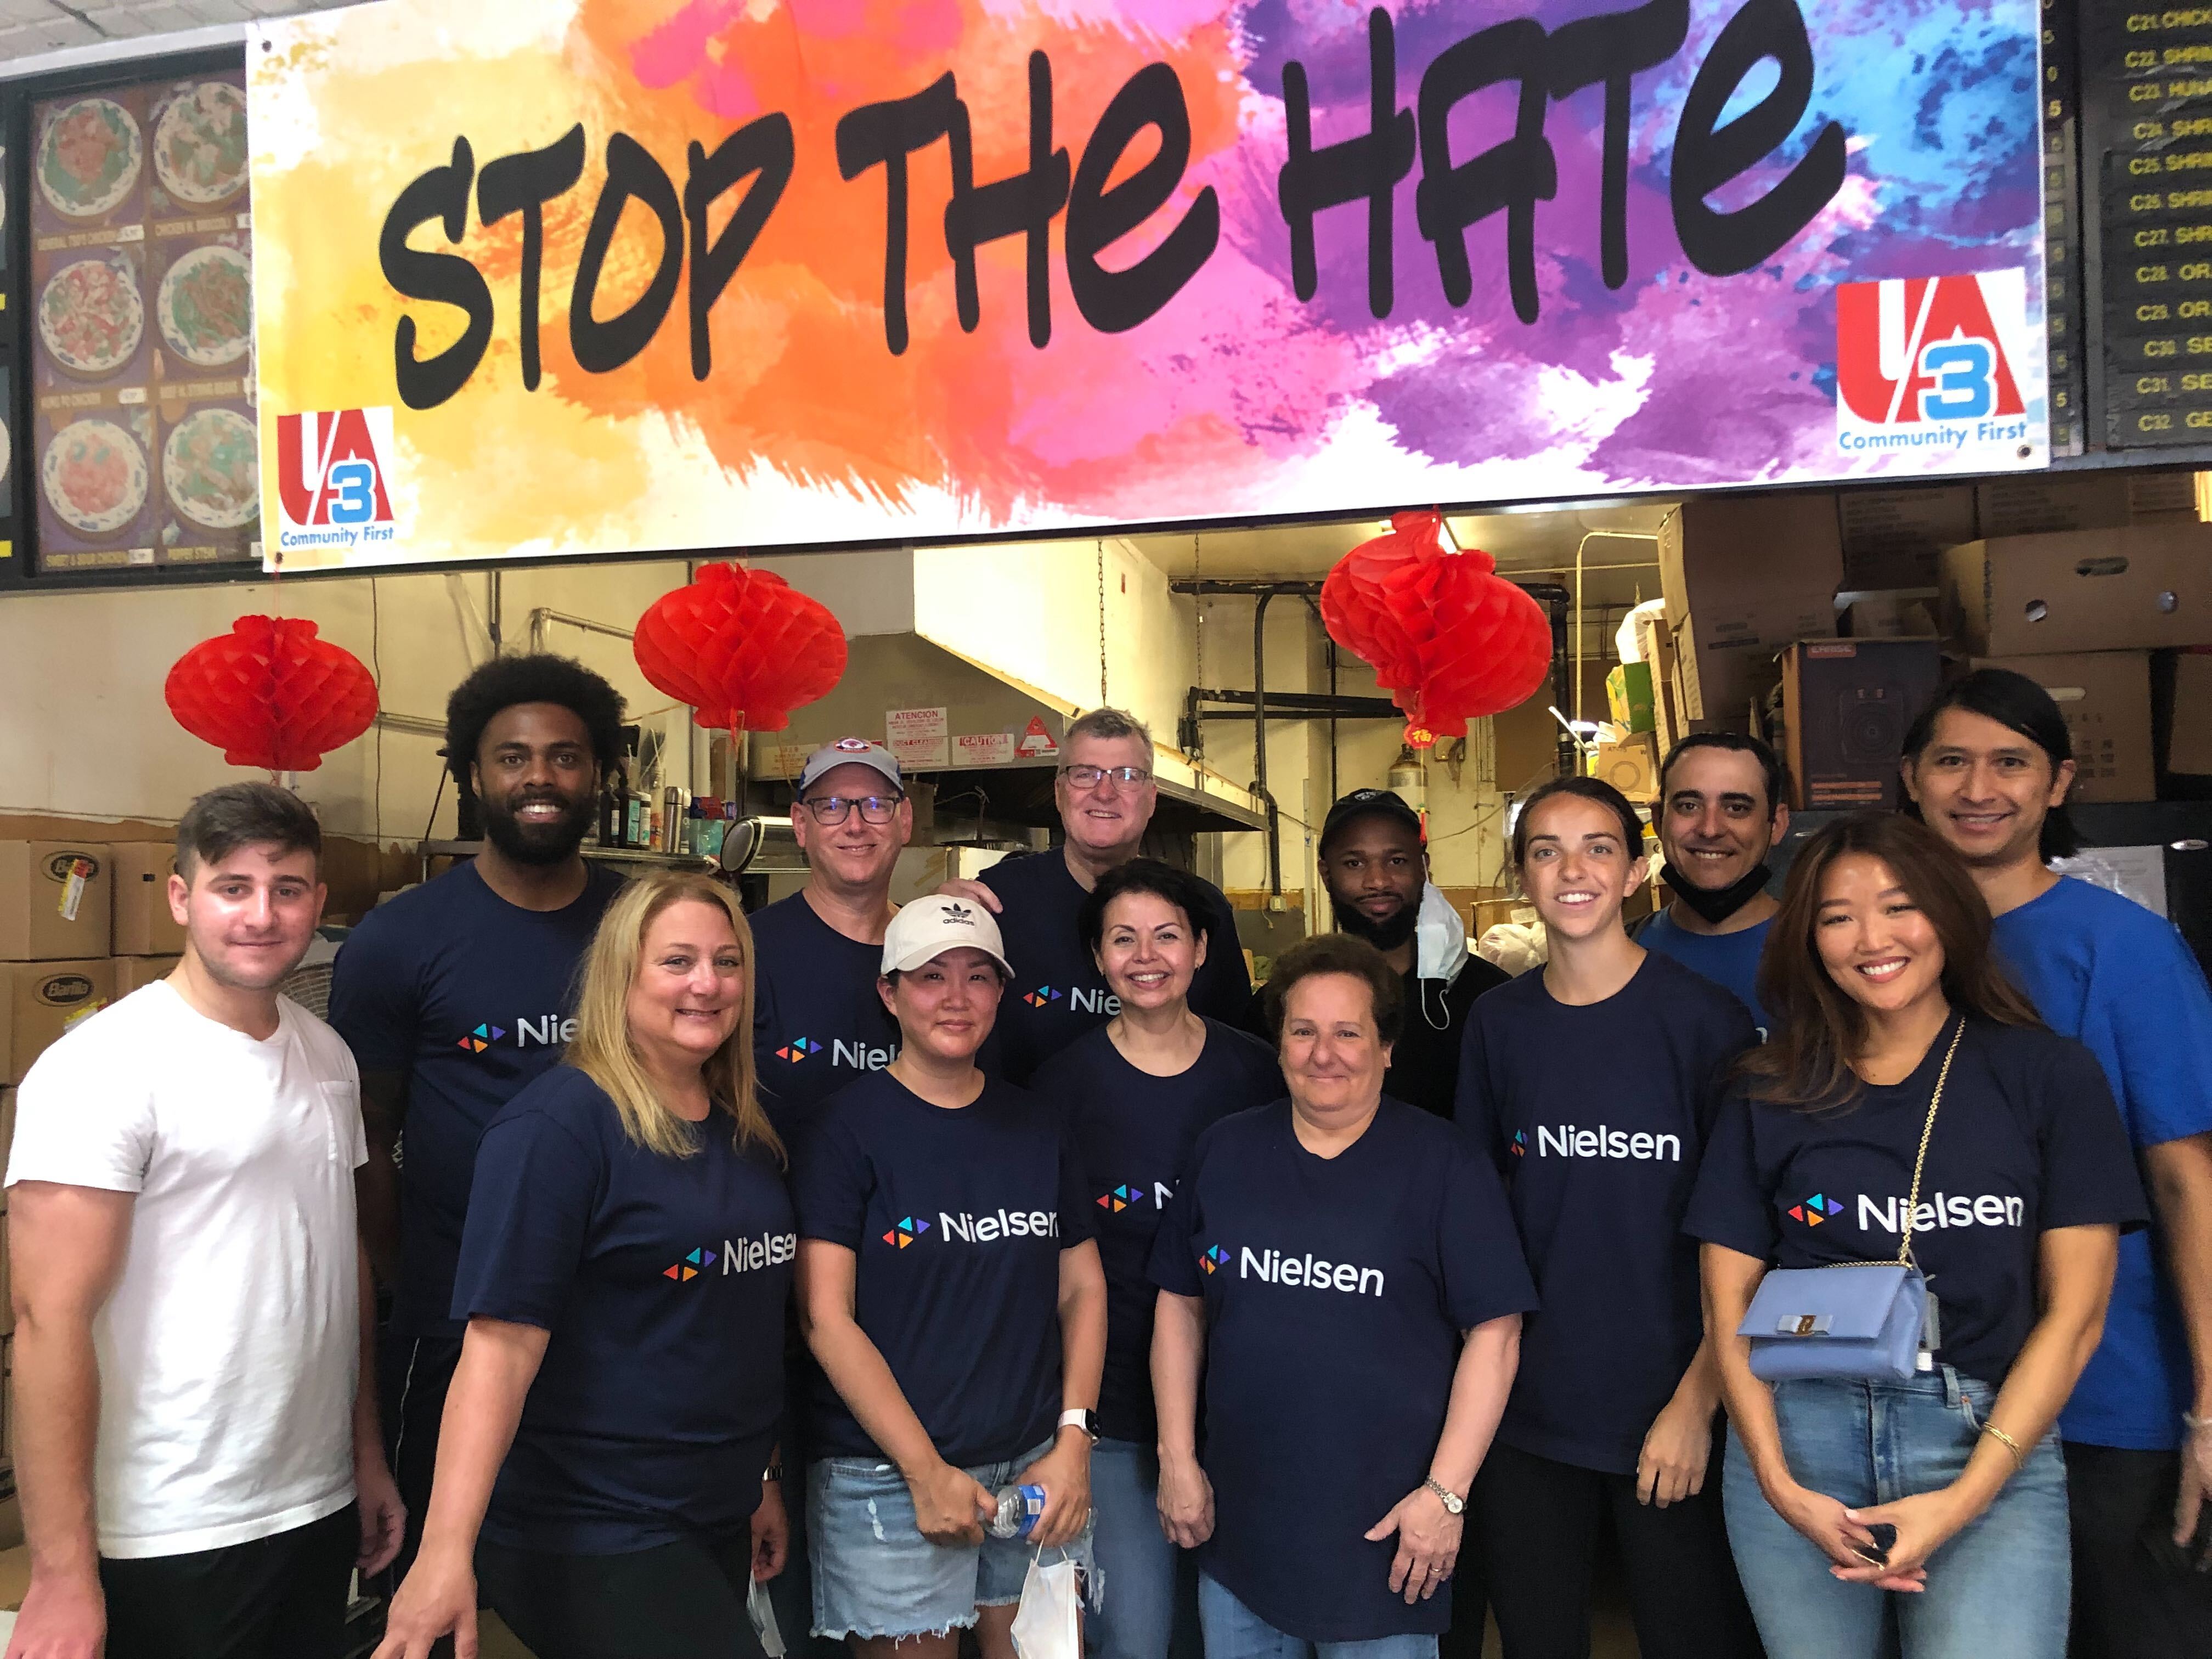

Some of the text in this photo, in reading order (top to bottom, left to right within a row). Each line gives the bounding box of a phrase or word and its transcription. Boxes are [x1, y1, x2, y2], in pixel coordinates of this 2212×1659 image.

[380, 112, 794, 409] STOP
[2056, 392, 2068, 408] 5
[1839, 421, 2027, 450] Community First
[281, 526, 394, 546] Community First
[895, 710, 939, 719] ATENCION
[1412, 729, 1432, 743] 福
[943, 917, 975, 926] adidas
[1538, 1125, 1680, 1161] Nielsen
[939, 1209, 1059, 1243] Nielsen
[1858, 1192, 2024, 1233] Nielsen
[723, 1232, 796, 1276] Nielse
[1240, 1246, 1384, 1296] Nielsen
